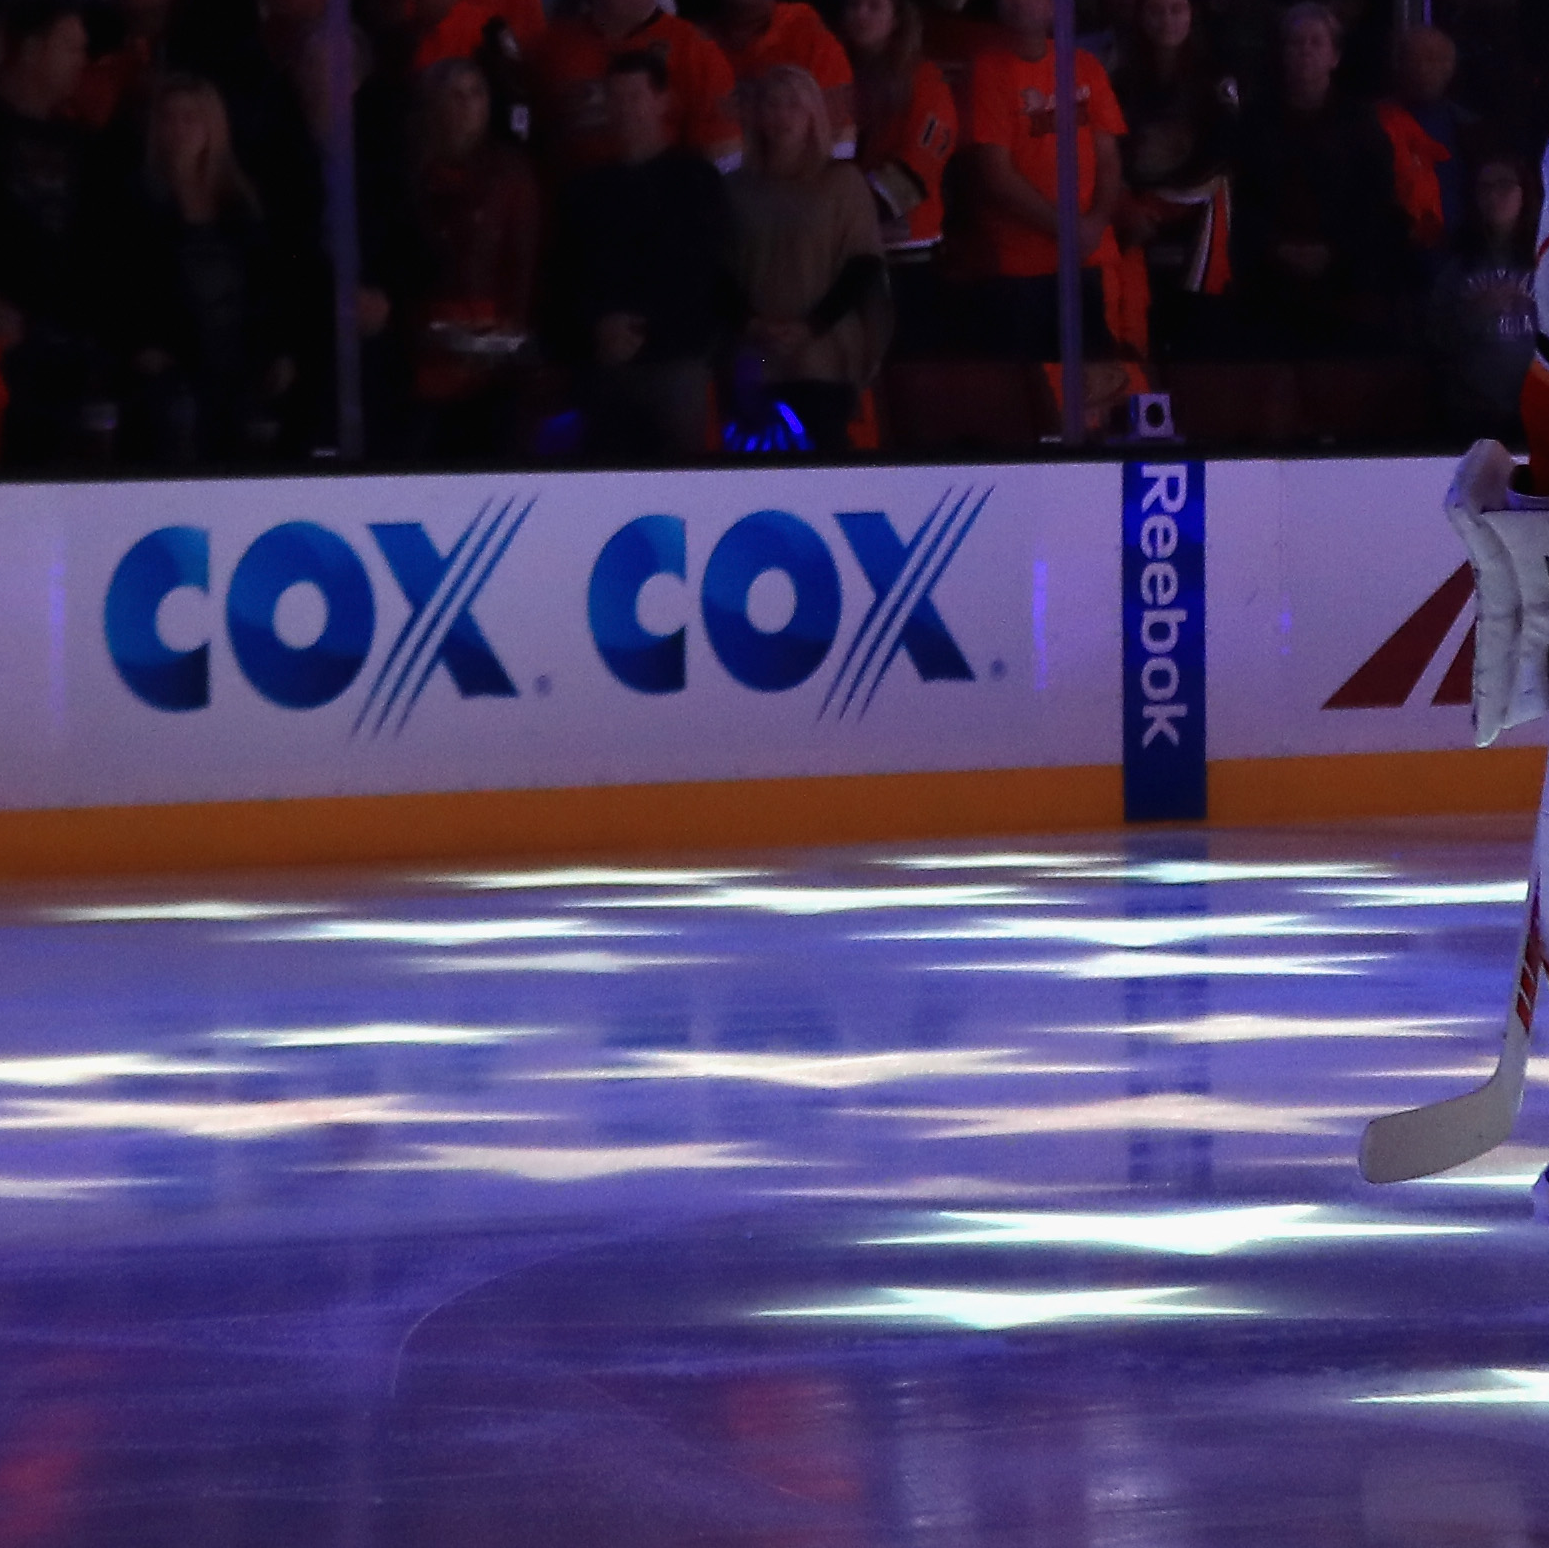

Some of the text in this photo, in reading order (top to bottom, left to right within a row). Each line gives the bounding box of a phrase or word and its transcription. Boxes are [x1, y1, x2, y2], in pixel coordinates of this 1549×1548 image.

[104, 485, 995, 741] COX COX
[1140, 463, 1189, 750] Reebok
